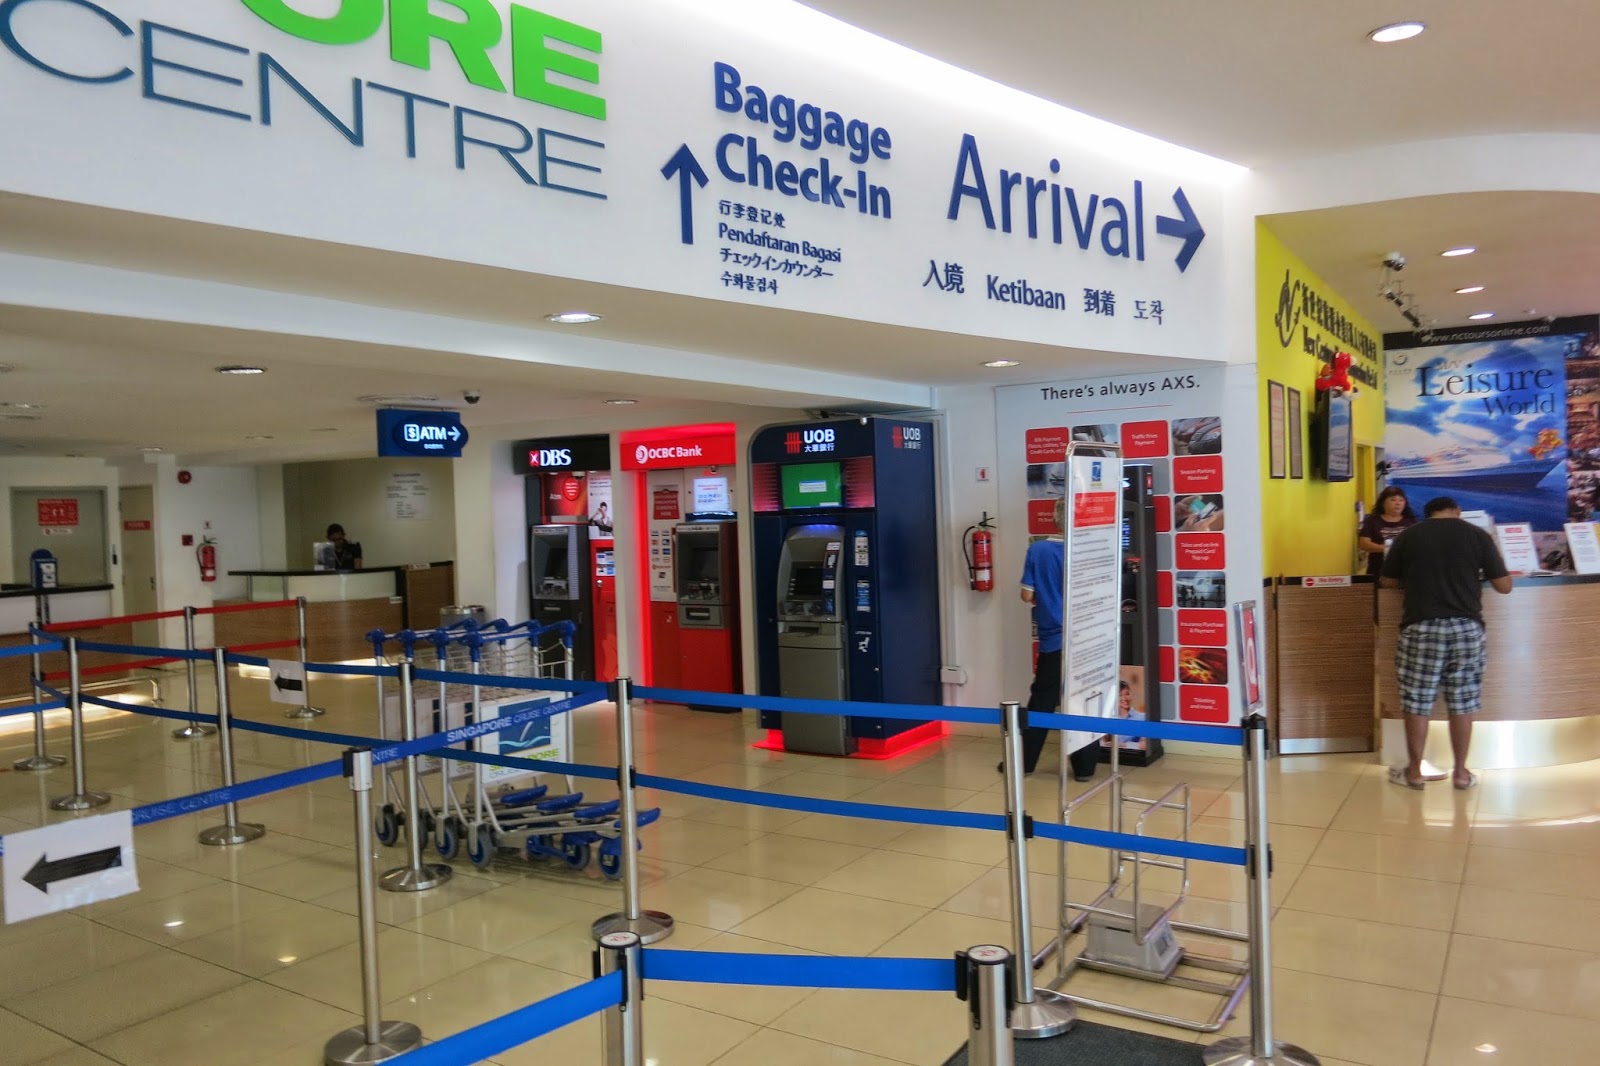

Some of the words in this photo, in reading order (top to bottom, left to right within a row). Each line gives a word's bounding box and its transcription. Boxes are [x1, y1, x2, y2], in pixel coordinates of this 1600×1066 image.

[0, 0, 608, 200] CENTRE
[714, 61, 892, 161] Baggage
[716, 133, 892, 219] Check-In
[947, 133, 1146, 262] Arrival
[719, 200, 786, 228] 行李登记处
[719, 223, 800, 254] Pendaftaran
[802, 241, 842, 263] Bagasi
[720, 248, 834, 278] チェックインカウンター
[922, 259, 965, 294] 入境
[720, 271, 779, 295] 수화물검사
[986, 274, 1066, 311] Ketibaan
[1133, 299, 1165, 326] 도착
[1421, 324, 1550, 343] ww.nctoursonline.com
[1041, 384, 1094, 401] There's
[1100, 381, 1155, 396] always
[1161, 375, 1201, 391] AXS.
[1417, 363, 1553, 398] Leisure
[1481, 393, 1556, 416] World
[420, 426, 447, 440] ATM
[804, 429, 835, 443] UOB
[903, 427, 921, 440] UOB
[540, 449, 572, 466] DBS
[649, 447, 675, 459] OCBC
[676, 445, 702, 457] Bank
[447, 716, 513, 742] SINGAPORE
[513, 709, 541, 724] CRUISE
[373, 747, 398, 761] NTRE
